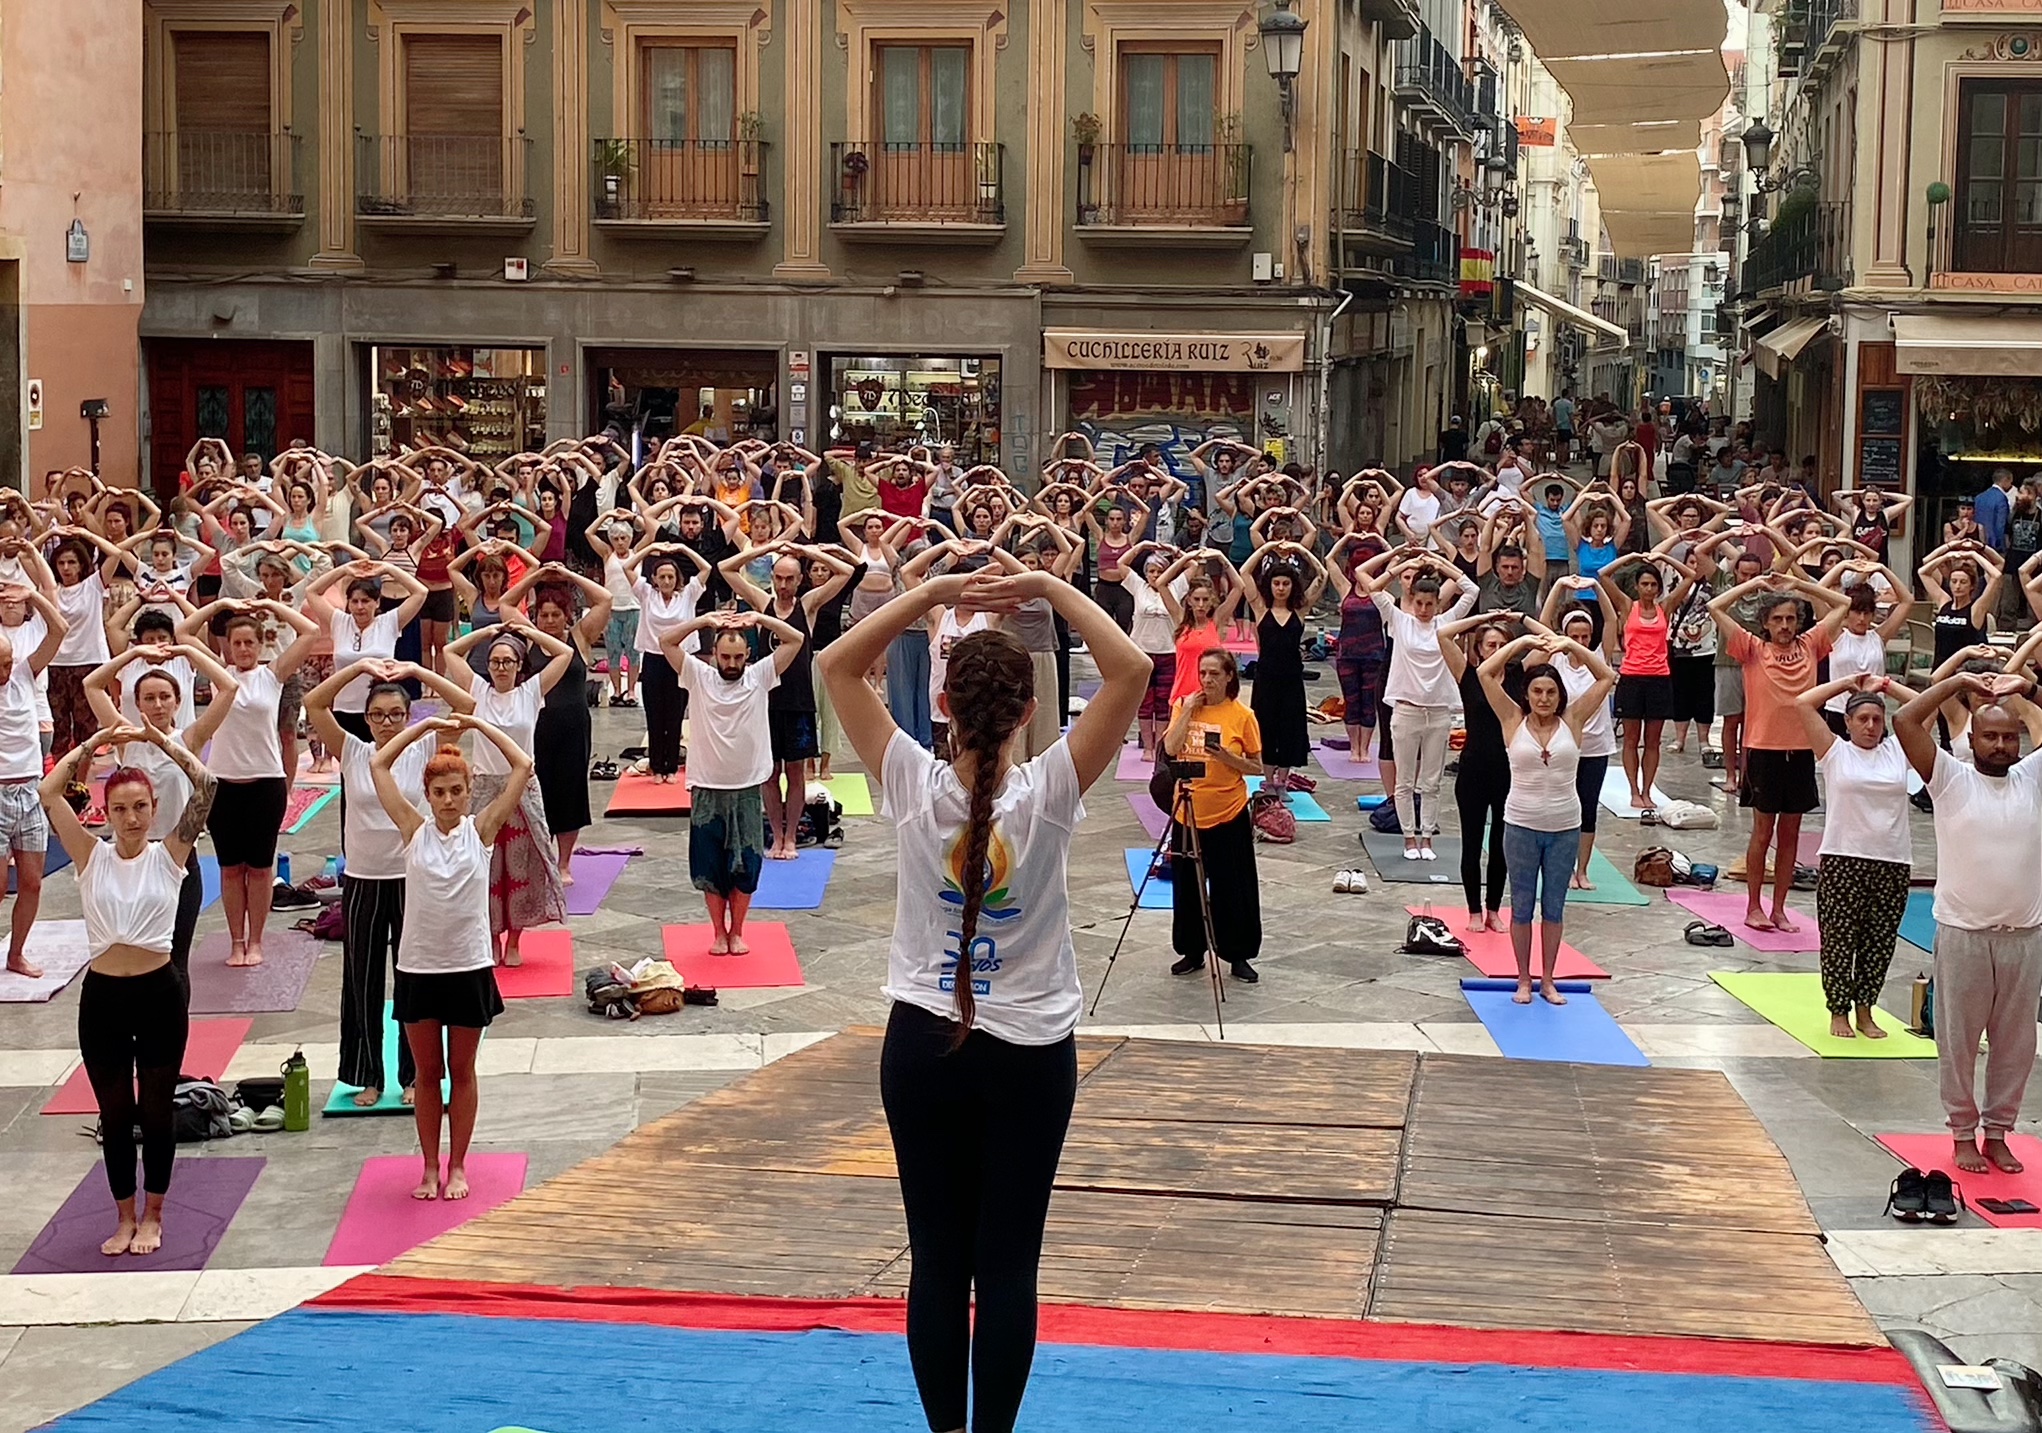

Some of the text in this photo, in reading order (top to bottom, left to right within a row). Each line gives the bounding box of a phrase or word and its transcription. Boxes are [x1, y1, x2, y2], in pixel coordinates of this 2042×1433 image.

[1951, 276, 1996, 289] CASA
[1067, 339, 1230, 360] CUCHILLERÍA RUIZ
[1935, 614, 1967, 626] adidas
